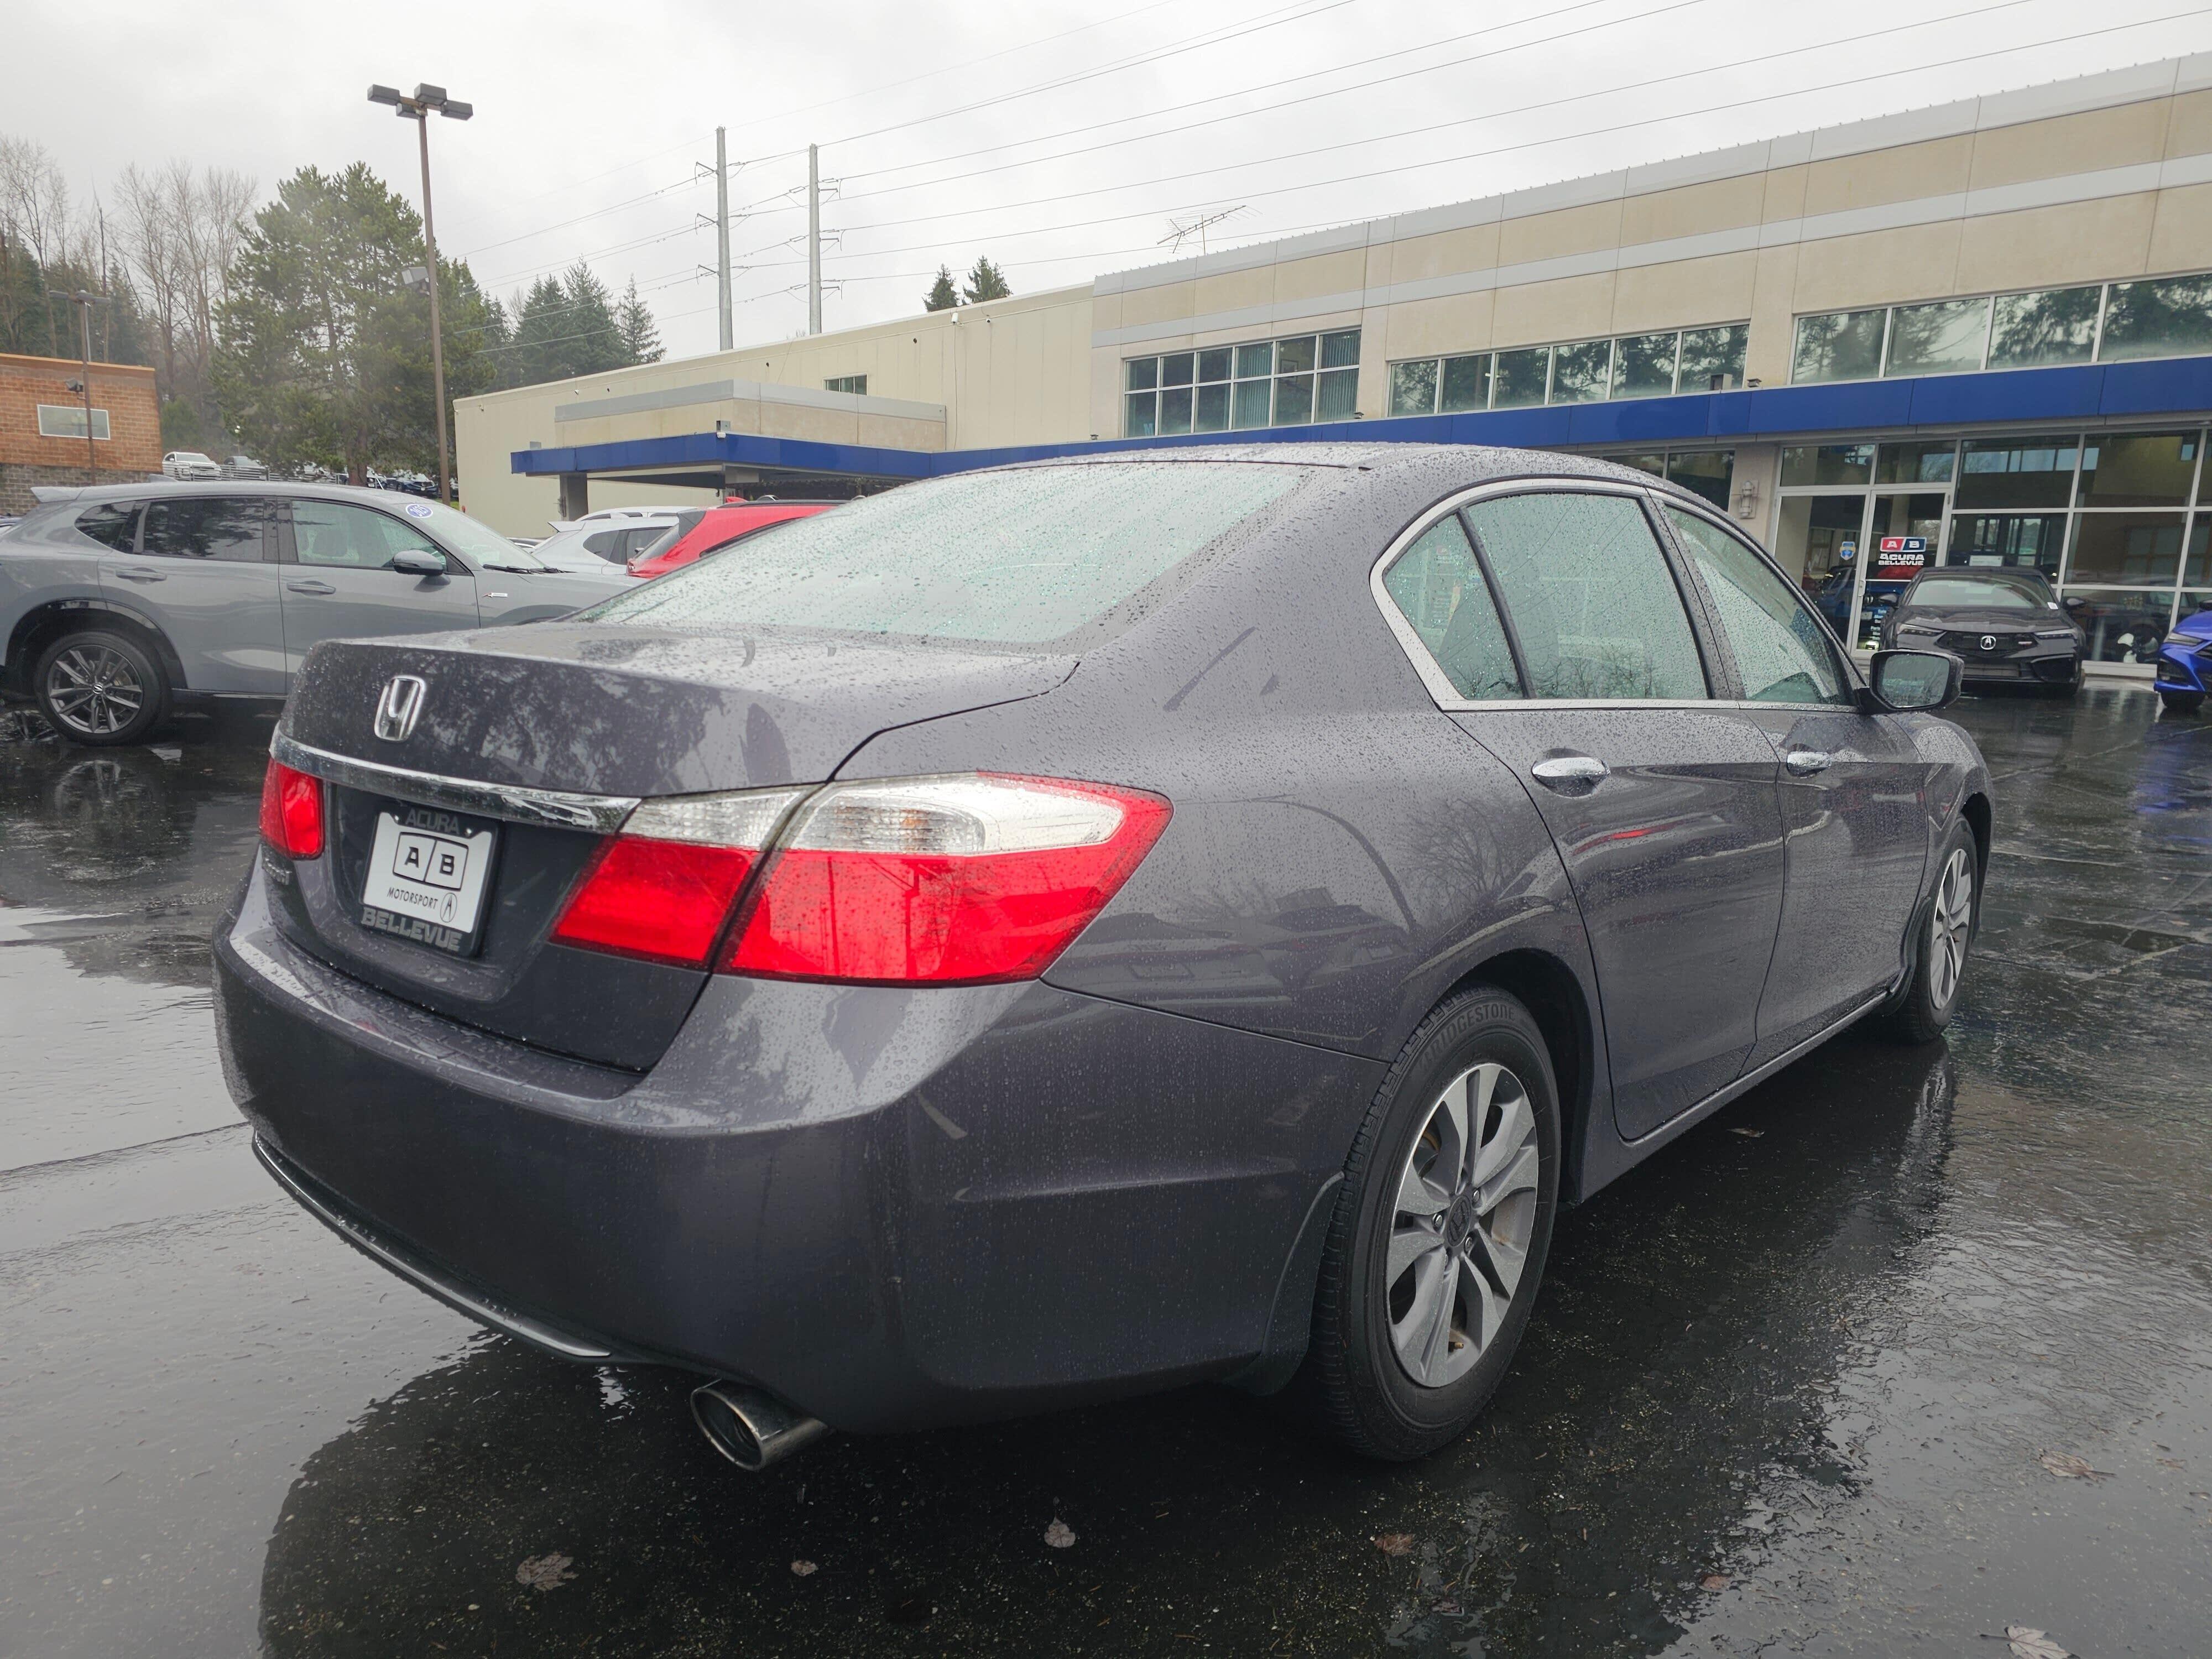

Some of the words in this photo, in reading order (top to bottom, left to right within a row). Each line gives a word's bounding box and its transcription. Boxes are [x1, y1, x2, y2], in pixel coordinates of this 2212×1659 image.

[405, 810, 460, 834] ACURA
[404, 847, 419, 868] A
[440, 854, 455, 876] B
[387, 887, 438, 909] MOTORSPORT
[361, 907, 462, 952] BELLEVUE
[1419, 1003, 1515, 1071] BRIDGESTONE
